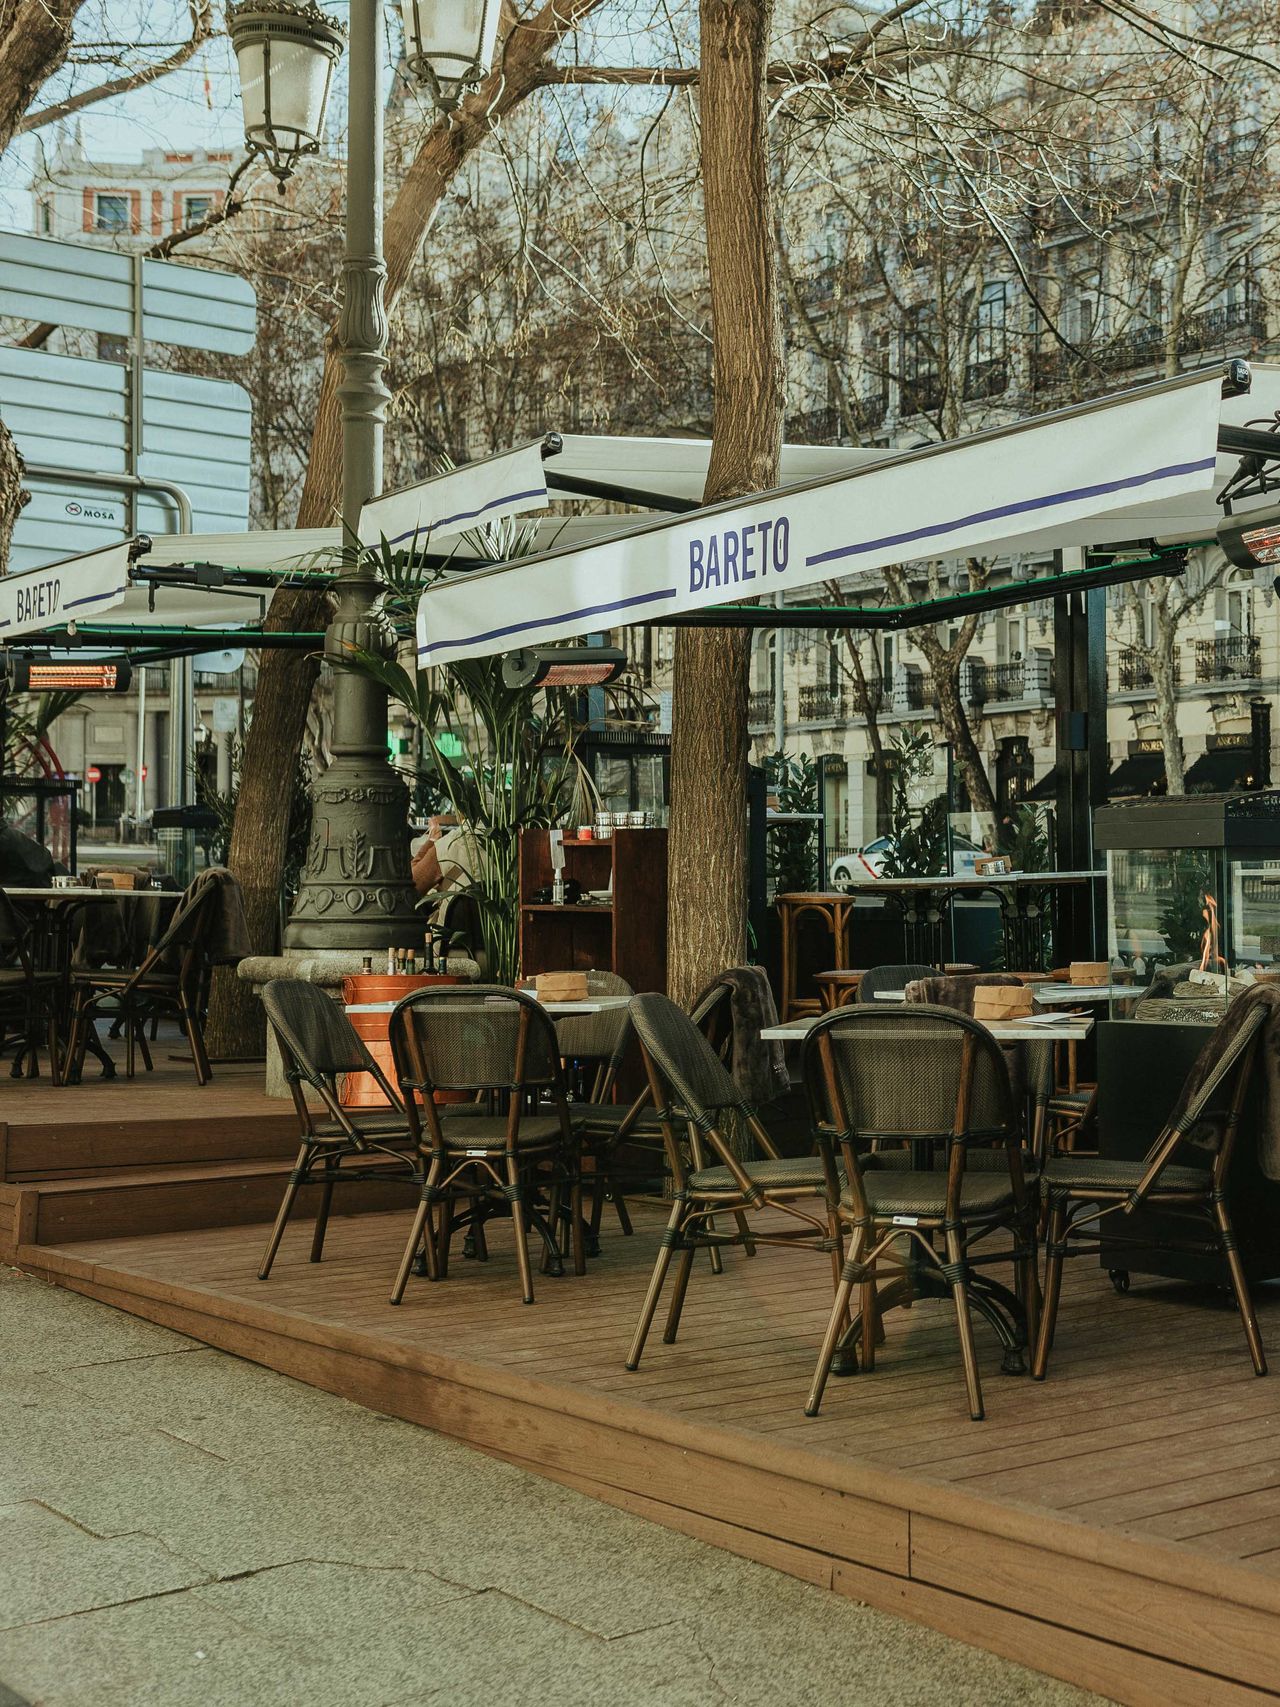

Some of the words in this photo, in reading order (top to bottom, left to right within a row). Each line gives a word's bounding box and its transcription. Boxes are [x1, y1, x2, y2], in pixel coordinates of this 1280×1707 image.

[84, 510, 114, 521] MOSA
[690, 517, 789, 592] BARETO
[17, 579, 61, 623] BARETO
